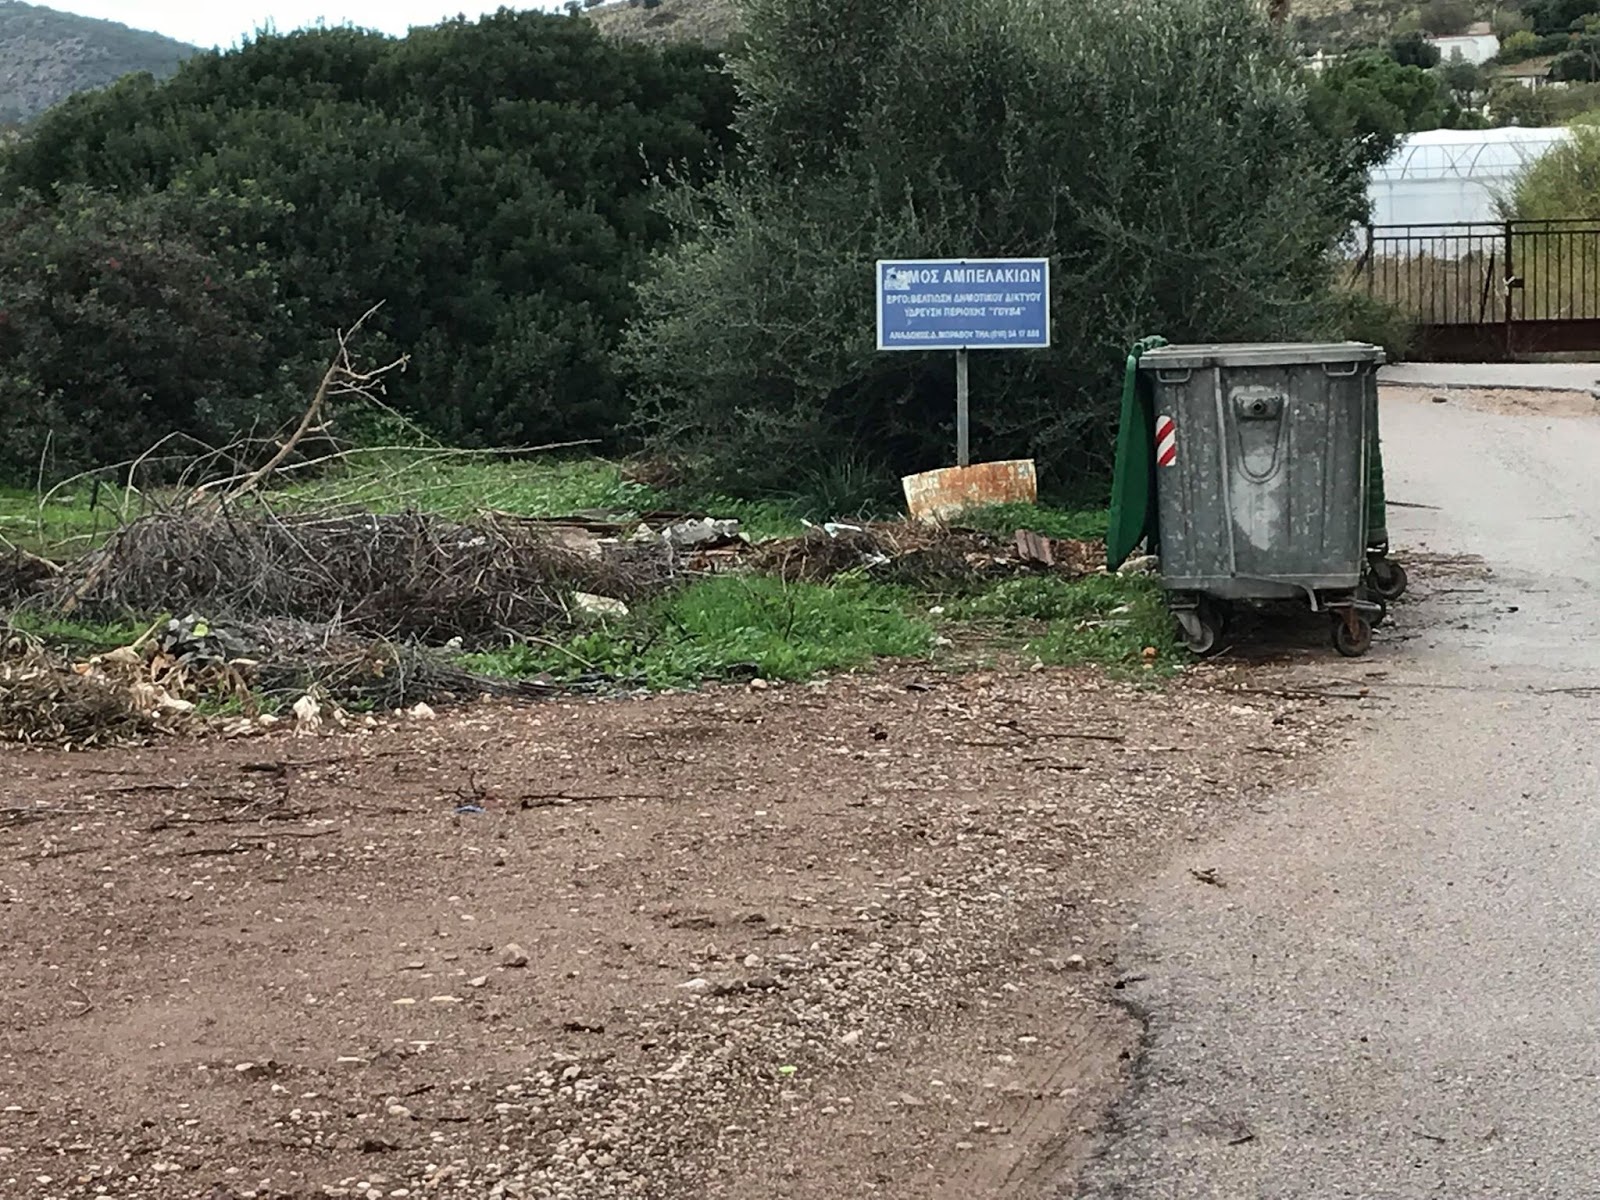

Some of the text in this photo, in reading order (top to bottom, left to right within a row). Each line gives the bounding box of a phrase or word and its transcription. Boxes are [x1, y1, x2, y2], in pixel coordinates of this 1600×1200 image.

[885, 268, 1041, 284] ΜΟΣ ΑΜΠΕΛΑΚΙΩΝ
[1005, 292, 1041, 302] ΔΙΚΤΥΟΥ
